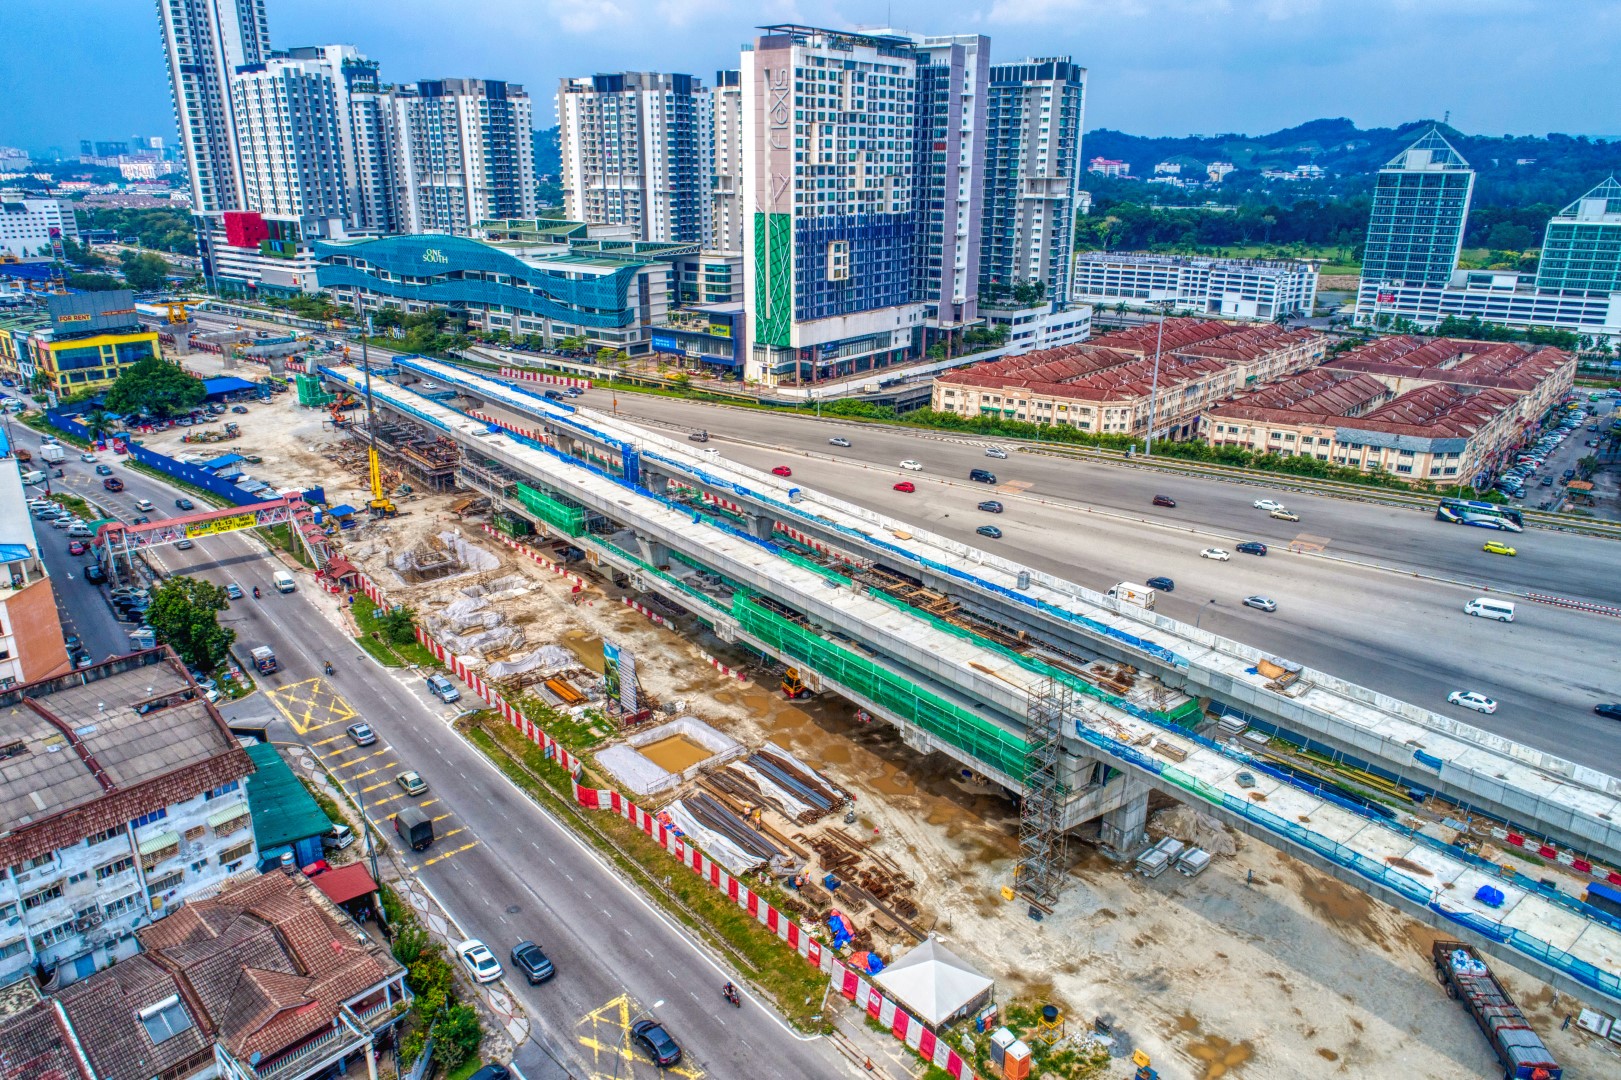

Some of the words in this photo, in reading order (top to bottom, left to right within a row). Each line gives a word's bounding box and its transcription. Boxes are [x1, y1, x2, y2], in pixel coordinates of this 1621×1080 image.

[426, 248, 442, 257] ONE
[422, 254, 449, 264] SOUTH
[73, 313, 91, 321] RENT
